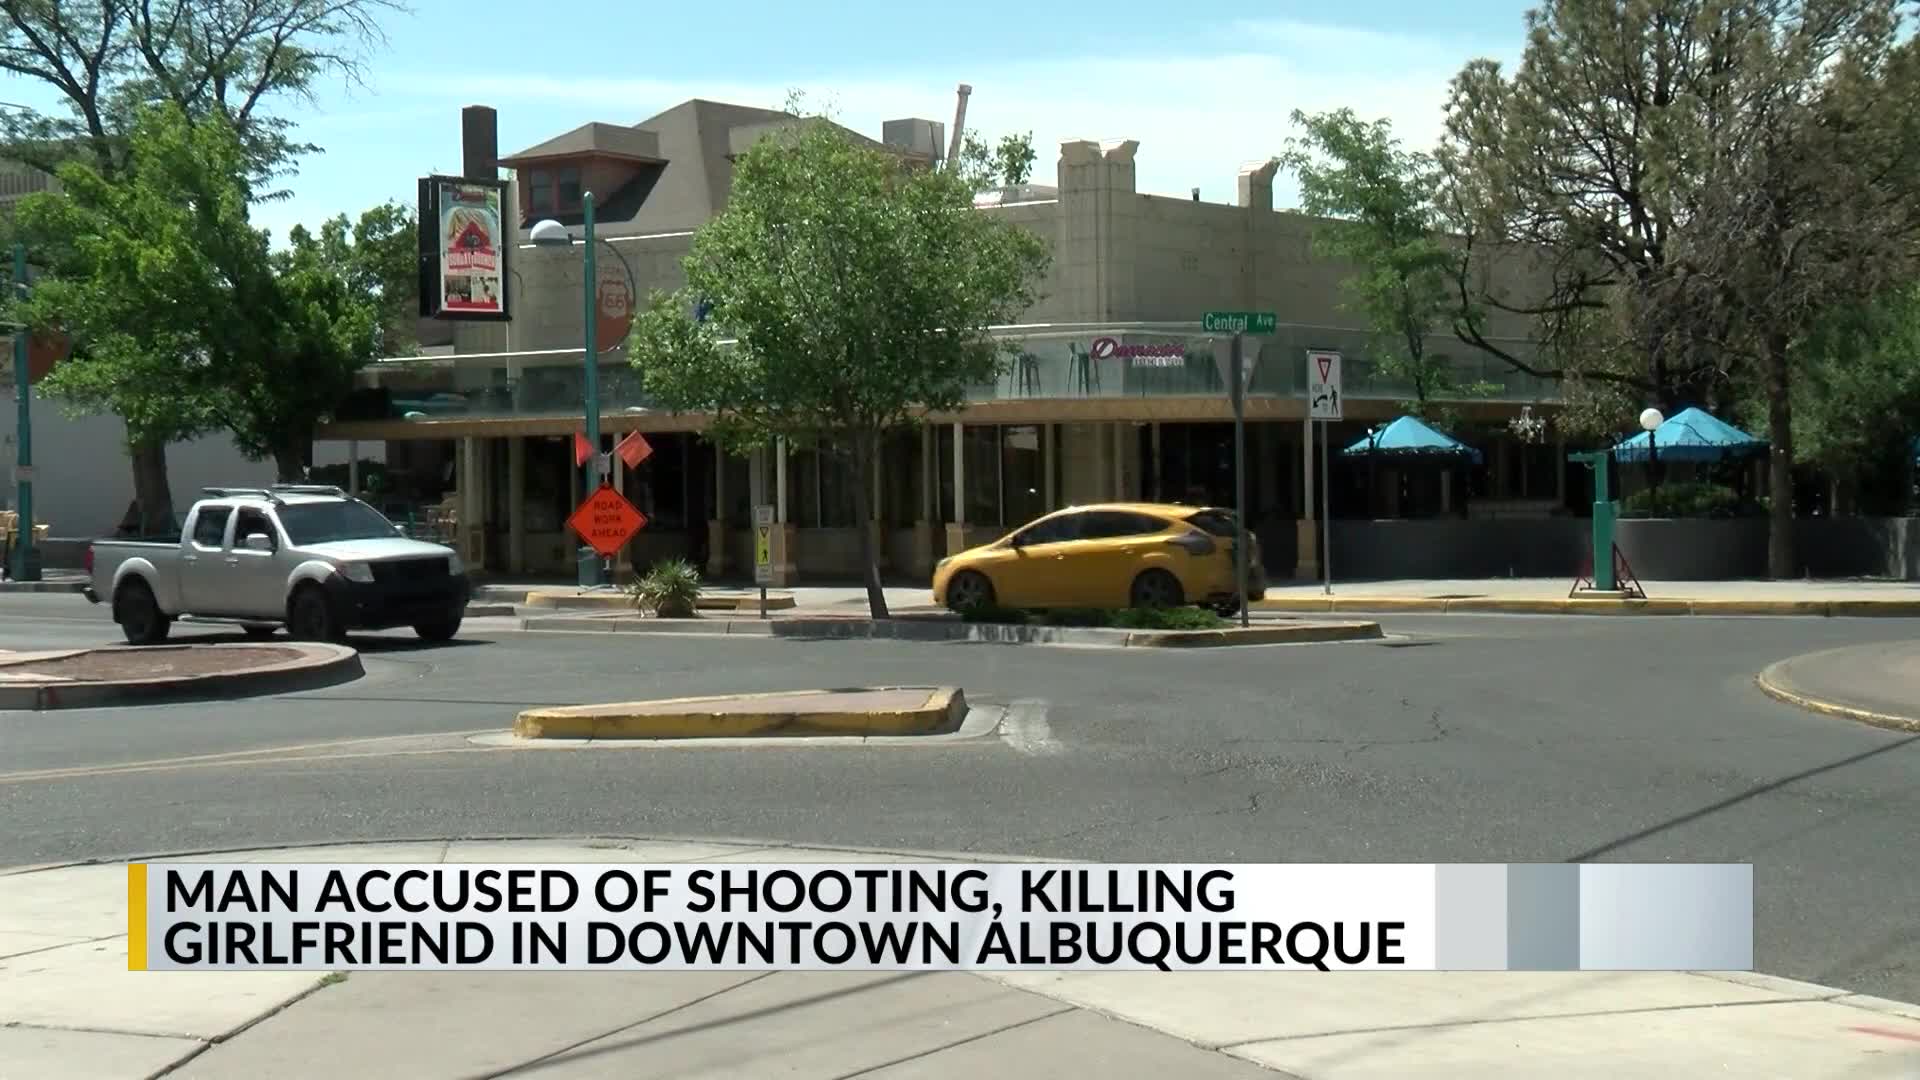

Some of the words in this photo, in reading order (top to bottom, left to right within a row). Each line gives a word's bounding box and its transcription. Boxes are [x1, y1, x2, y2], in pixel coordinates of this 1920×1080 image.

[1205, 312, 1248, 331] Central
[1256, 314, 1274, 327] Ave
[593, 500, 623, 511] ROAD
[593, 514, 622, 525] WORK
[591, 527, 627, 537] AHEAD
